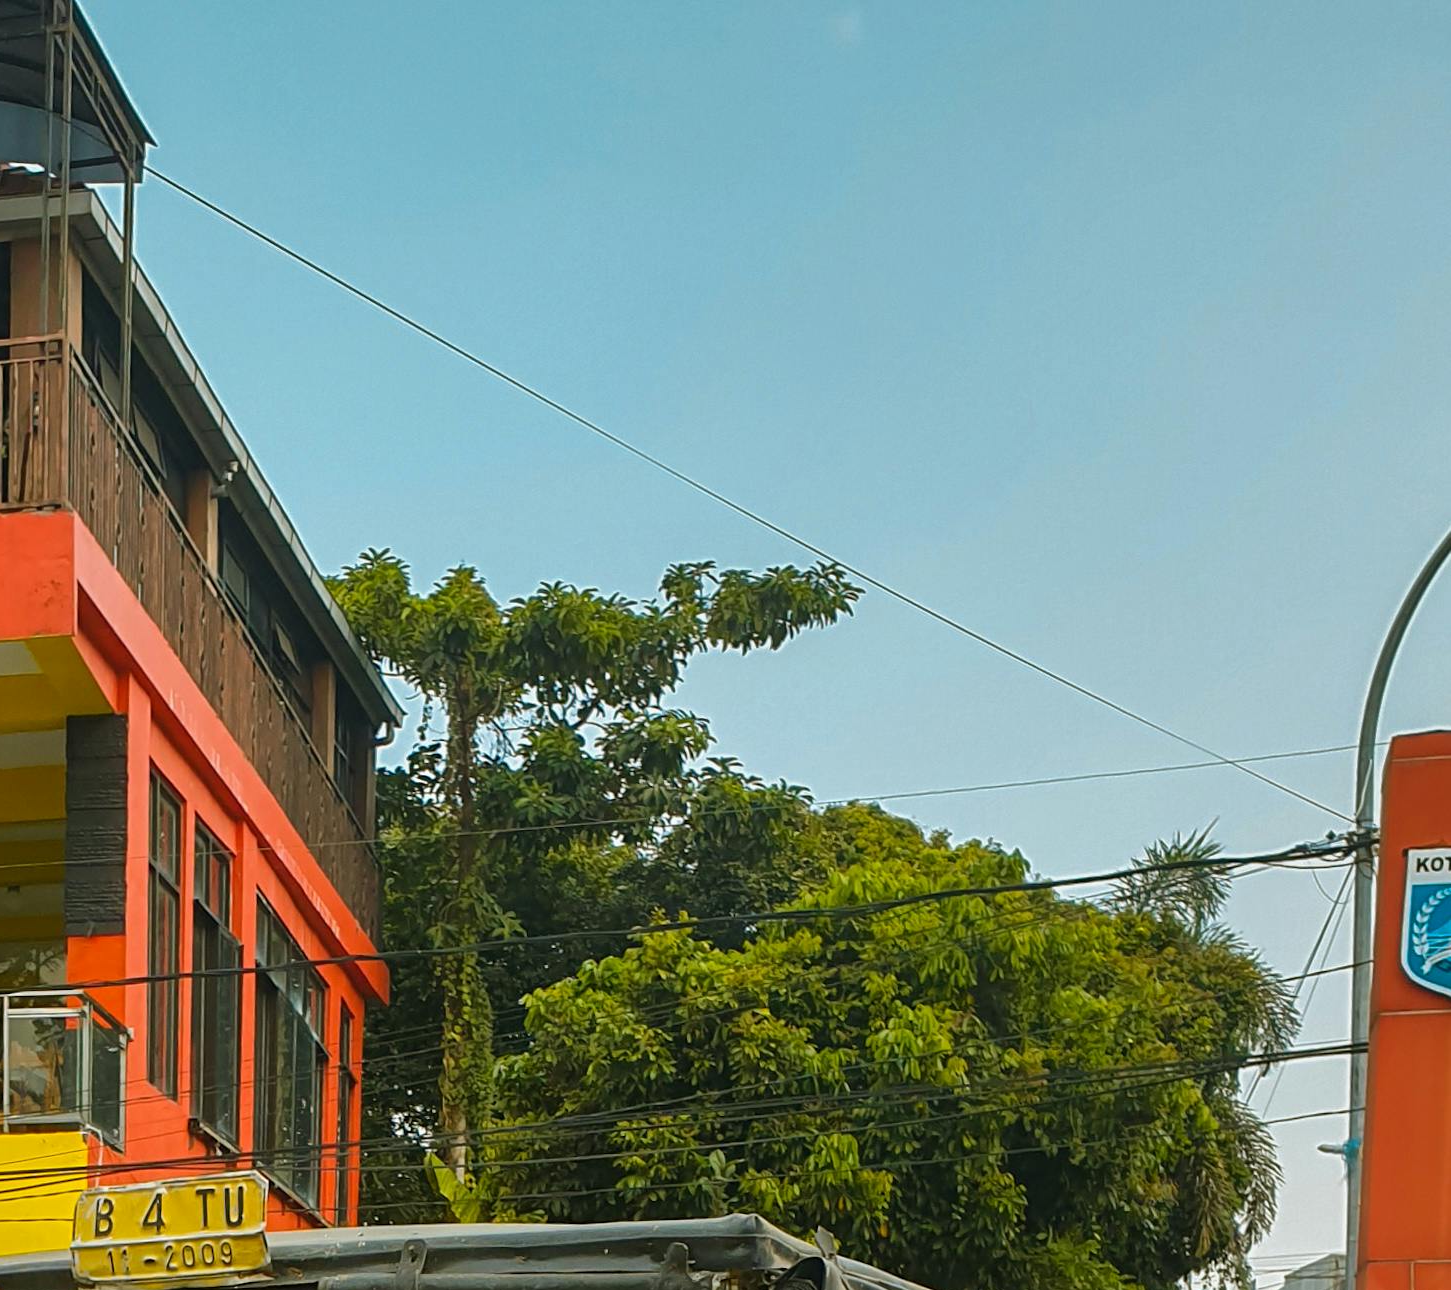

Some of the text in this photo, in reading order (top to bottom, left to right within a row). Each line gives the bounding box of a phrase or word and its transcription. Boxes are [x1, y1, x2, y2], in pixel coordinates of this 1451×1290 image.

[95, 1186, 247, 1238] B 4 TU
